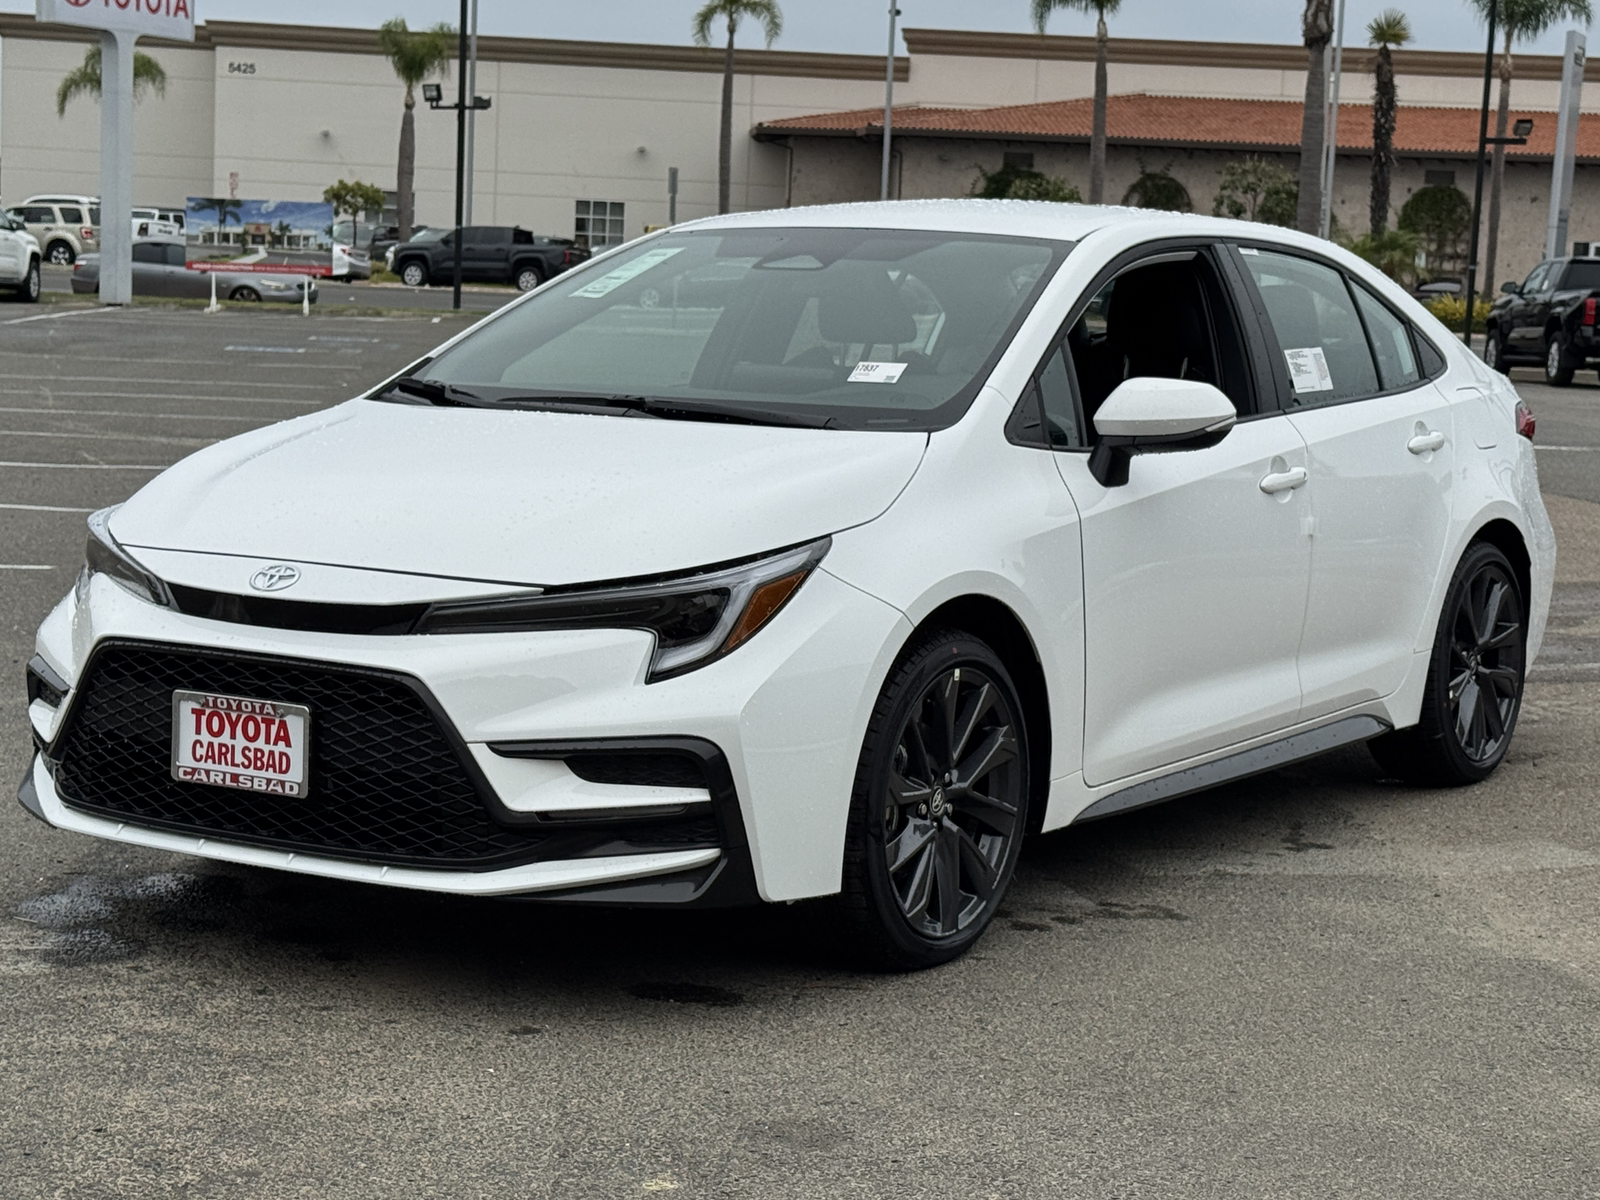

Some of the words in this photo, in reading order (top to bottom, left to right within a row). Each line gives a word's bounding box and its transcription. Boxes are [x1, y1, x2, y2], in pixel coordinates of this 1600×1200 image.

[104, 0, 189, 19] OTA
[228, 61, 256, 74] 5425
[206, 696, 275, 716] TOYOTA
[191, 707, 292, 748] TOYOTA
[191, 739, 291, 775] CARLSBAD
[178, 766, 299, 796] CARLSBAD
